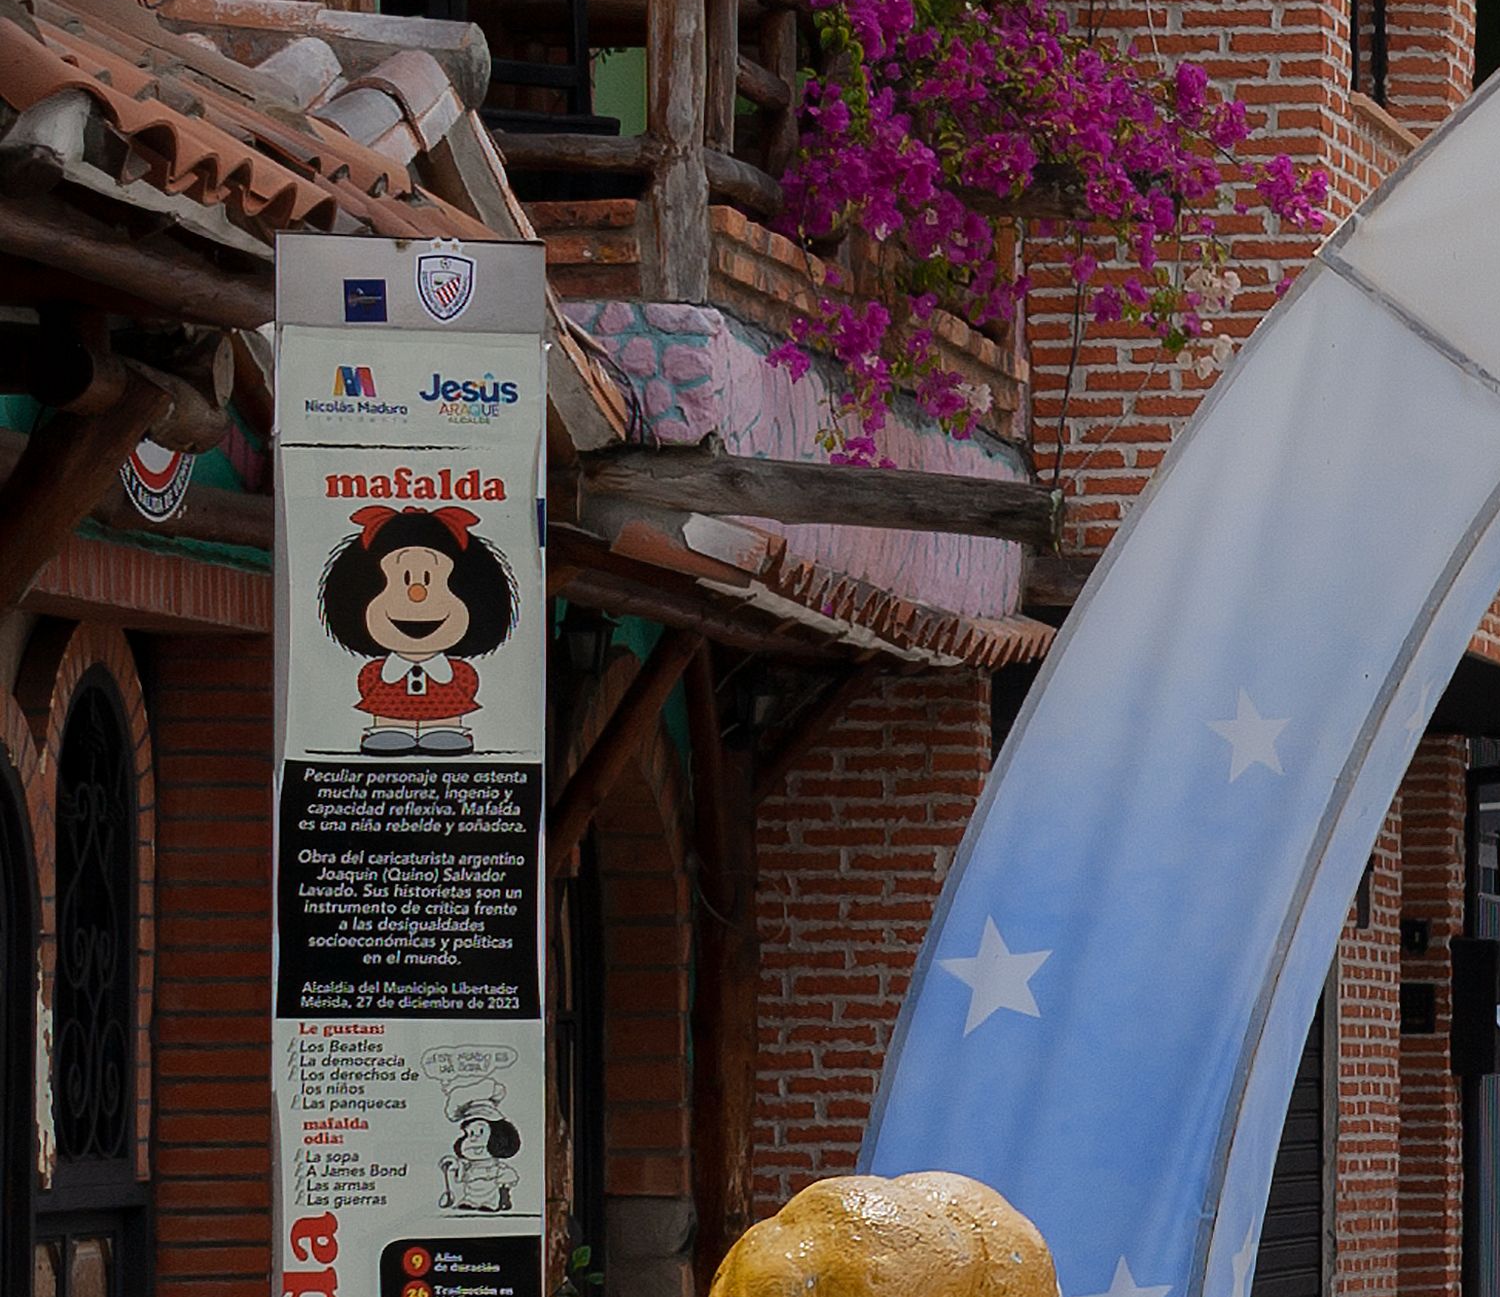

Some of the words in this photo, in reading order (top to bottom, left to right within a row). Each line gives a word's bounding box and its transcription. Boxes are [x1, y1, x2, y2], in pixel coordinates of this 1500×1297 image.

[358, 401, 408, 415] Maduro
[439, 403, 499, 418] ARAQUE
[325, 467, 507, 502] mafalda
[304, 768, 362, 783] Peculiar
[366, 771, 438, 785] personaje
[442, 773, 469, 790] que
[474, 770, 527, 784] ostenta
[317, 786, 367, 799] mucha
[445, 787, 499, 803] ingenio
[503, 790, 513, 804] y
[307, 803, 384, 818] capacidad
[389, 803, 456, 816] reflexiva.
[462, 803, 521, 816] Mafalda
[299, 820, 315, 831] es
[320, 821, 346, 832] una
[351, 819, 381, 832] niña
[386, 818, 441, 832] rebelde
[446, 822, 455, 836] y
[458, 819, 527, 833] soñadora.
[298, 850, 336, 864] Obra
[341, 850, 364, 864] del
[368, 852, 455, 866] caricaturista
[459, 853, 524, 869] argentino
[383, 867, 439, 883] (Quino)
[443, 868, 507, 882] Salvador
[298, 884, 358, 897] Lavado.
[363, 884, 389, 898] Sus
[394, 884, 471, 899] historietas
[476, 887, 500, 899] son
[506, 888, 522, 899] un
[304, 900, 396, 914] instrumento
[401, 901, 420, 915] de
[474, 901, 517, 915] frente
[339, 921, 347, 930] a
[353, 917, 373, 930] las
[378, 917, 485, 934] desigualdades
[308, 934, 436, 949] socioeconómicas
[441, 937, 450, 951] y
[363, 953, 382, 964] en
[386, 951, 401, 964] el
[405, 952, 462, 965] mundo.
[302, 981, 354, 994] Alcaldía
[358, 981, 380, 994] del
[384, 982, 448, 997] Municipio
[452, 982, 518, 995] Libertador
[300, 995, 352, 1010] Mérida,
[357, 996, 373, 1008] 27
[377, 996, 394, 1009] de
[399, 996, 463, 1009] diciembre
[467, 997, 484, 1009] de
[488, 997, 520, 1009] 2023
[299, 1022, 318, 1035] Le
[323, 1024, 385, 1038] gustan:
[299, 1041, 325, 1052] Los
[330, 1040, 384, 1052] Beatles
[300, 1055, 321, 1066] La
[322, 1055, 405, 1067] democracia
[300, 1068, 326, 1081] Los
[330, 1069, 396, 1081] derechos
[401, 1069, 419, 1081] de
[302, 1083, 322, 1095] los
[326, 1083, 365, 1095] niños
[302, 1098, 326, 1109] Las
[330, 1099, 407, 1112] panquecas
[303, 1117, 369, 1130] mafalda
[304, 1132, 344, 1146] odia:
[306, 1150, 322, 1163] La
[326, 1153, 360, 1166] sopa
[306, 1165, 317, 1176] A
[322, 1165, 366, 1177] James
[371, 1164, 407, 1177] Bond
[307, 1180, 329, 1191] Las
[332, 1181, 375, 1191] armas
[307, 1194, 330, 1205] Las
[334, 1195, 387, 1209] guerras
[411, 1255, 423, 1269] 9
[434, 1263, 446, 1272] de
[499, 1287, 513, 1295] en
